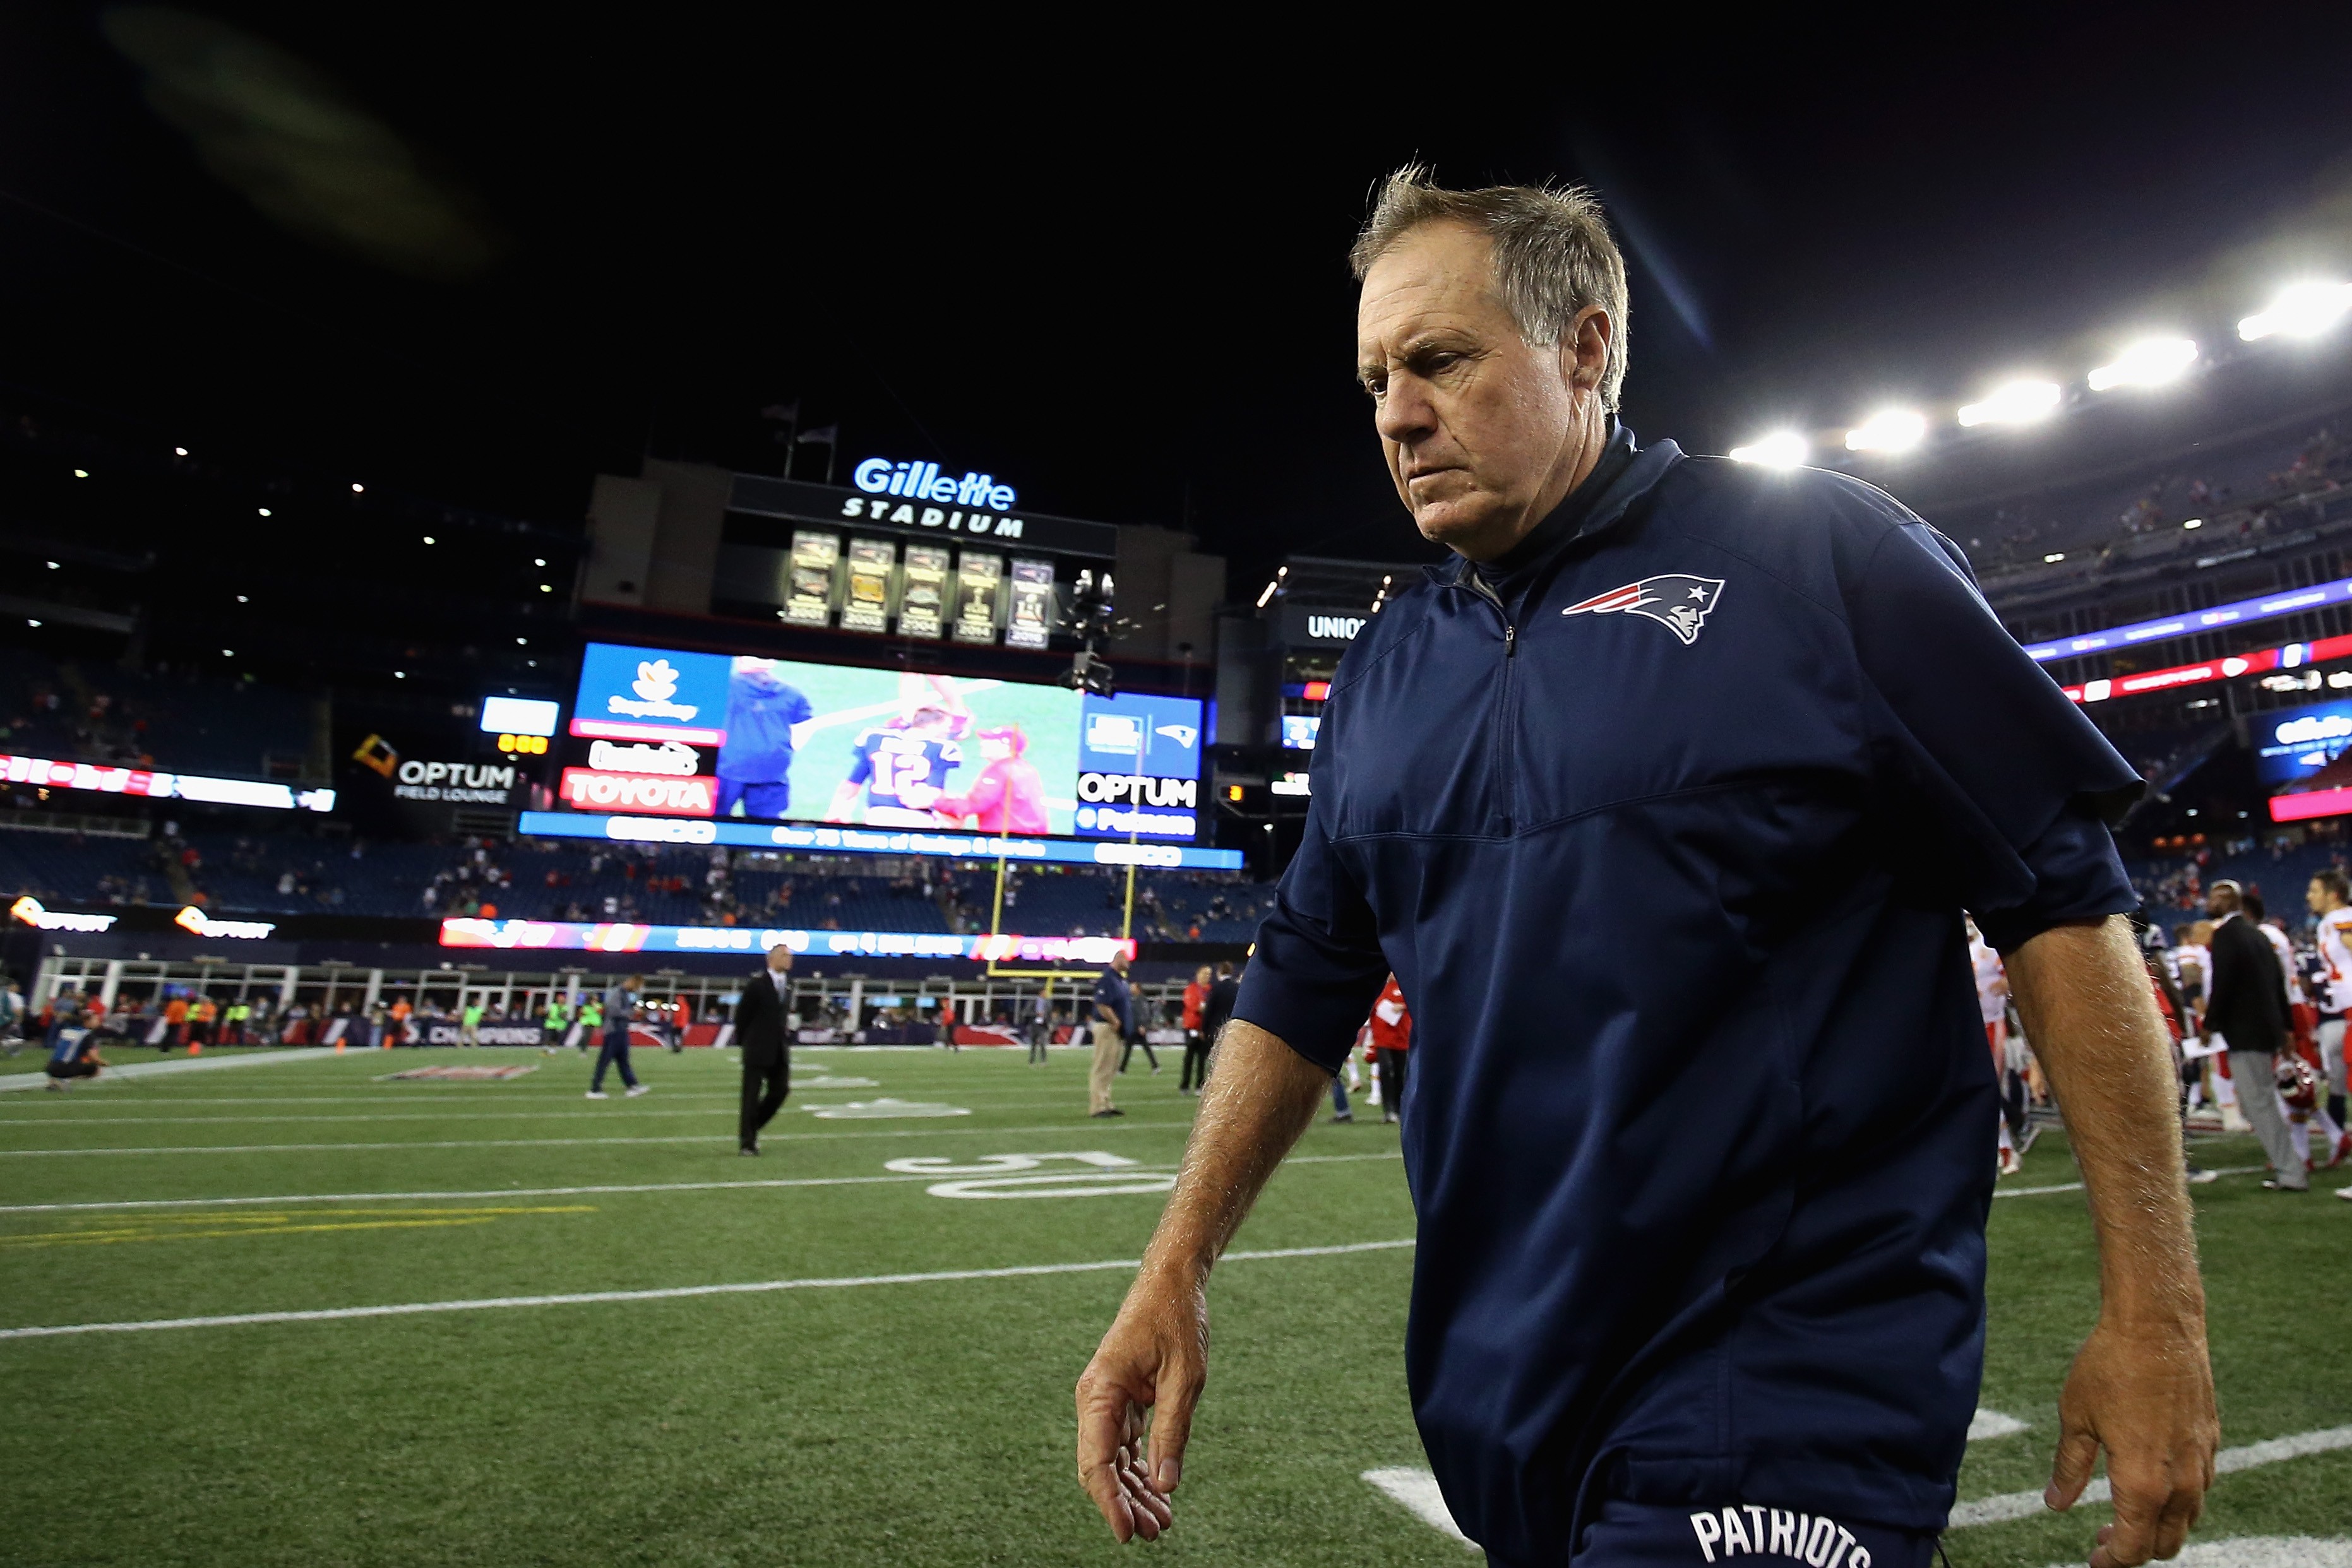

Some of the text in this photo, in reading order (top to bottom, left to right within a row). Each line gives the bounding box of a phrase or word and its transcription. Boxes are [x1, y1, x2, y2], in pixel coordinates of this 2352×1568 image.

[854, 457, 1016, 511] Gillette
[842, 497, 1024, 538] STADIUM
[1308, 615, 1367, 640] UNIO
[399, 761, 515, 789] OPTUM
[568, 774, 710, 809] TOYOTA
[1078, 773, 1197, 807] OPTUM
[394, 785, 507, 804] FIELD LOUNGE
